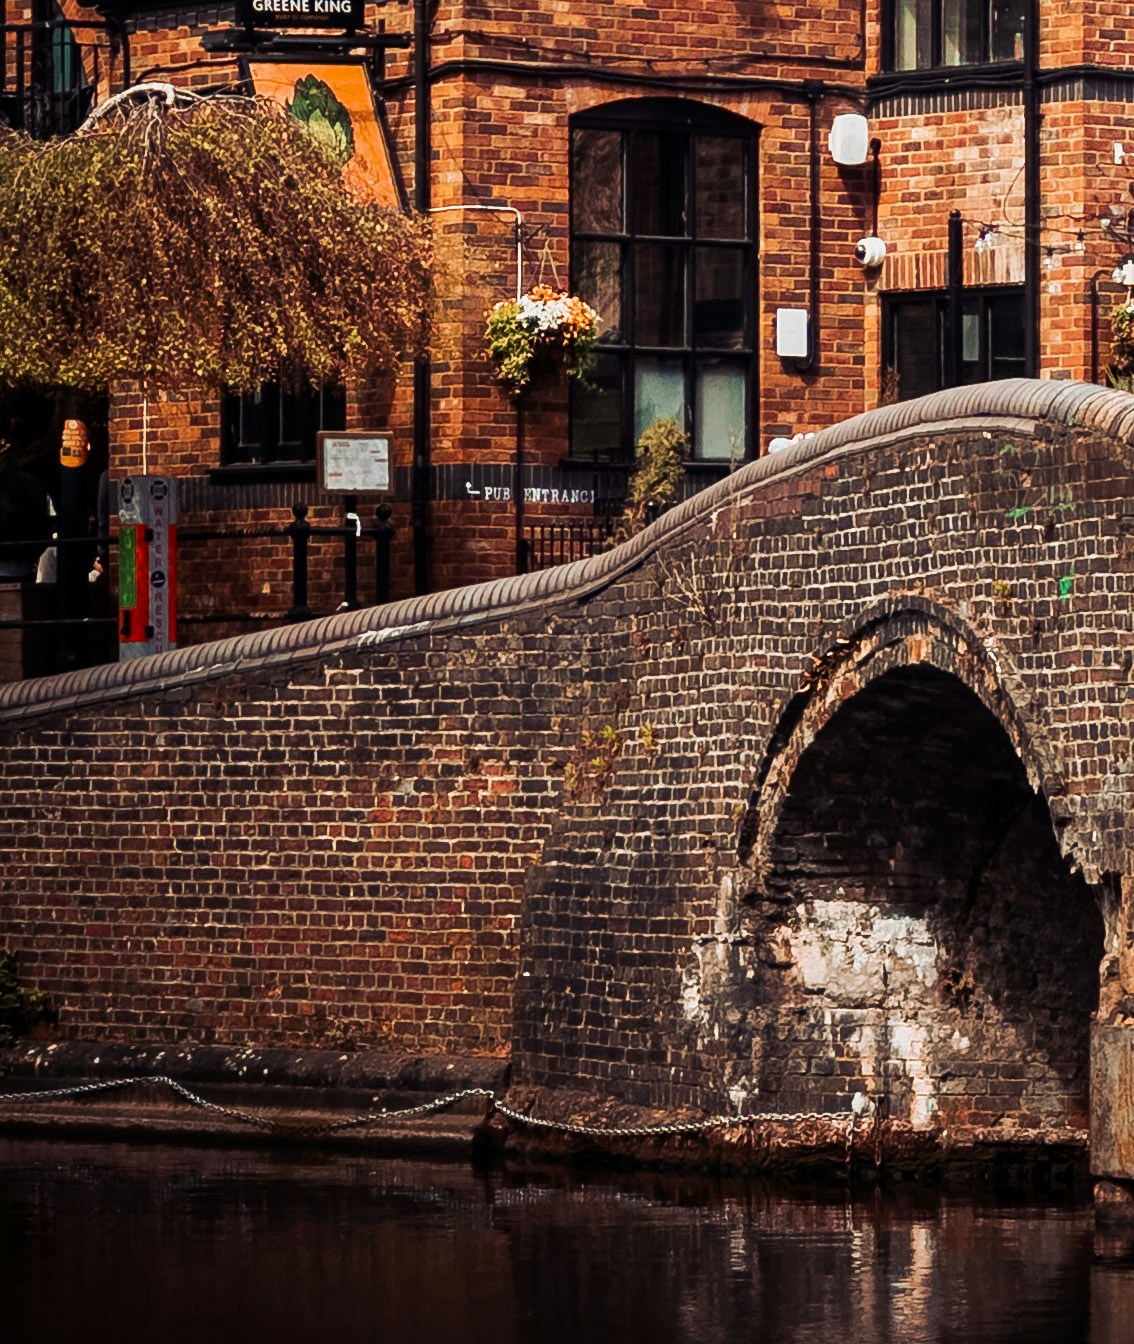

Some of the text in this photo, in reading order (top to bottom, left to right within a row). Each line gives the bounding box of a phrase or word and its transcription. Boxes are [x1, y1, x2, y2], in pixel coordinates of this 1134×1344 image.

[314, 0, 352, 14] KING
[484, 486, 511, 501] PUB
[153, 505, 164, 654] WATER RESCU
